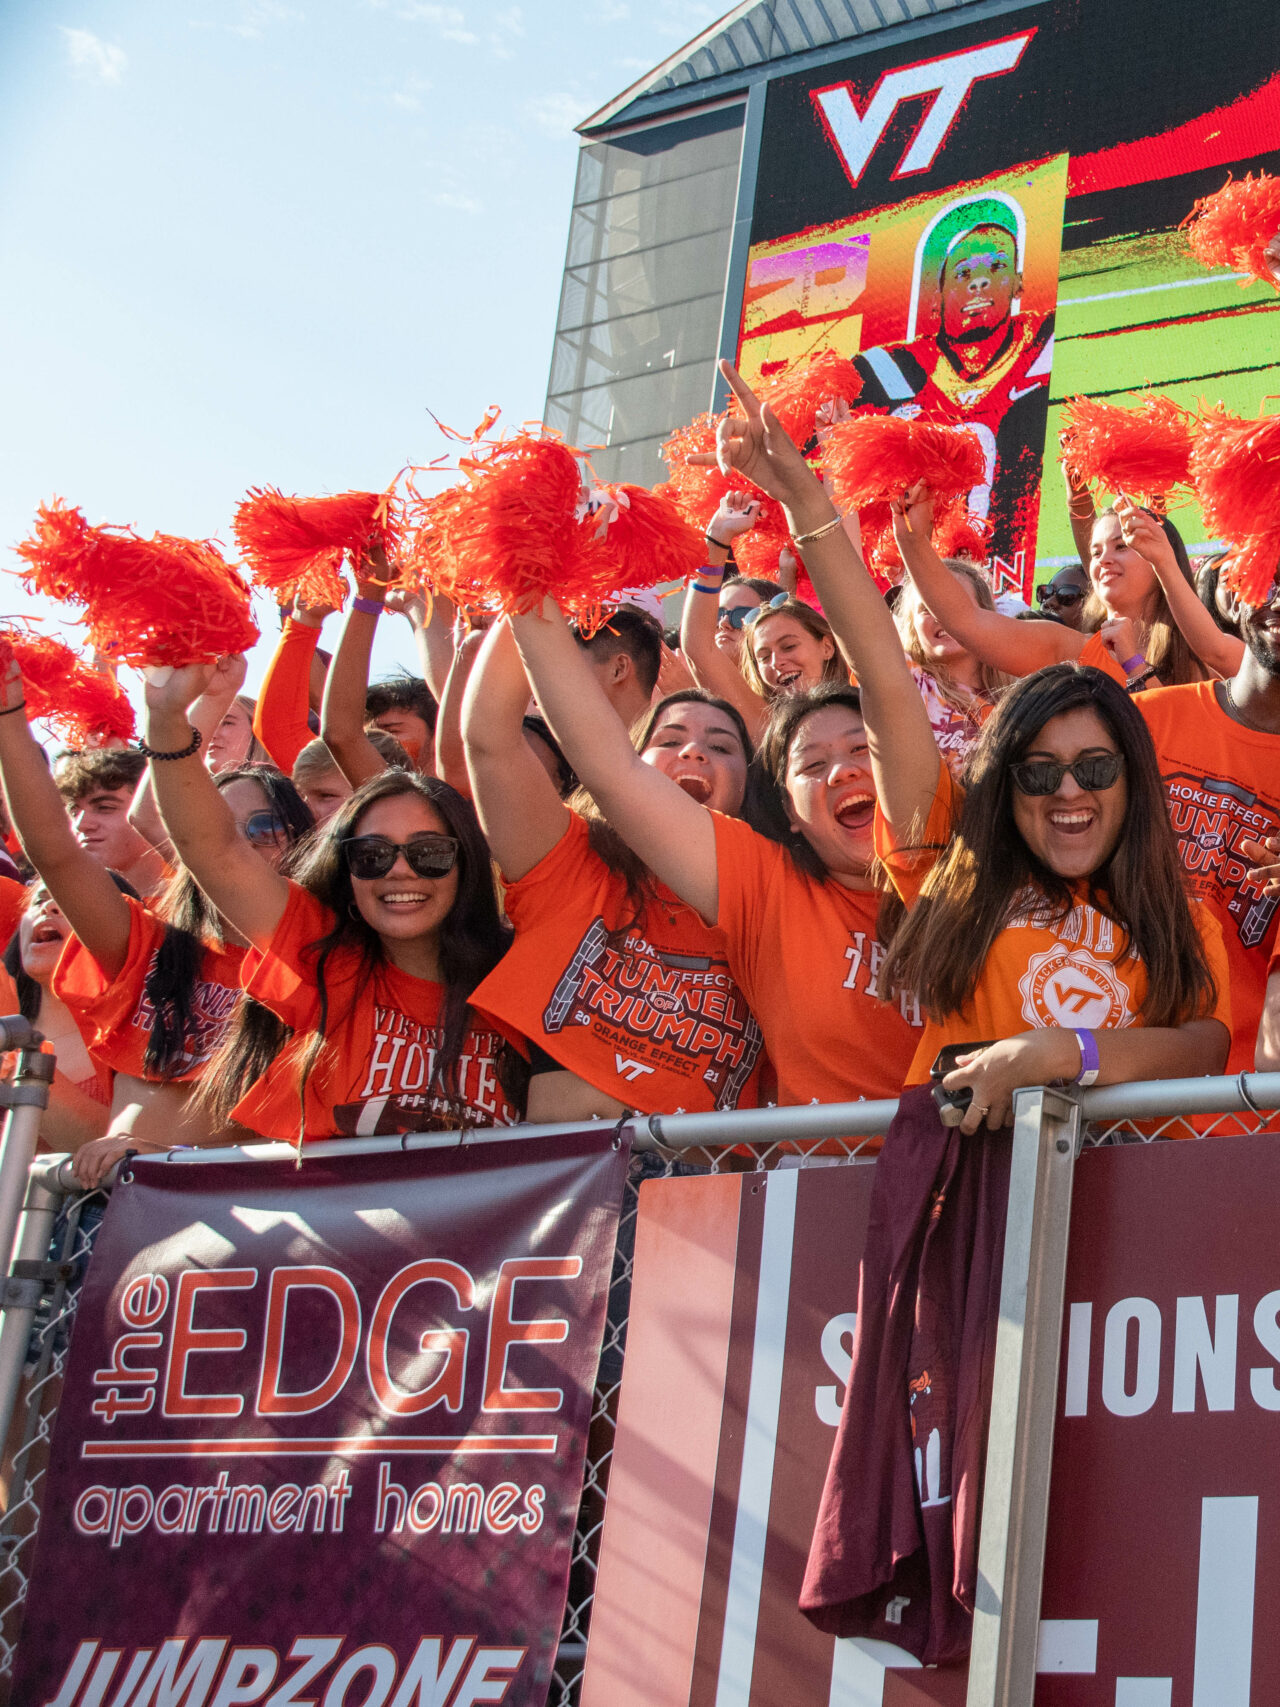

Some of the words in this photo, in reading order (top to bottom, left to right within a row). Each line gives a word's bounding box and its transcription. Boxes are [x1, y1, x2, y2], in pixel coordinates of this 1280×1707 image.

[808, 28, 1037, 187] VT
[1169, 783, 1218, 808] HOKIE
[1220, 797, 1273, 830] EFFECT
[1227, 900, 1241, 913] 21
[624, 935, 662, 960] HOK
[602, 947, 744, 1031] TUNNEL
[653, 998, 677, 1012] OF
[1053, 980, 1105, 1014] VT
[577, 965, 747, 1069] TRIUMPH
[574, 1010, 592, 1027] 20
[703, 1068, 721, 1084] 21
[592, 1021, 649, 1055] ORANGE
[650, 1047, 700, 1074] EFFECT
[614, 1053, 655, 1081] VT
[92, 1272, 171, 1424] the
[162, 1254, 583, 1418] EDGE
[73, 1465, 352, 1548] apartment
[375, 1462, 546, 1536] homes
